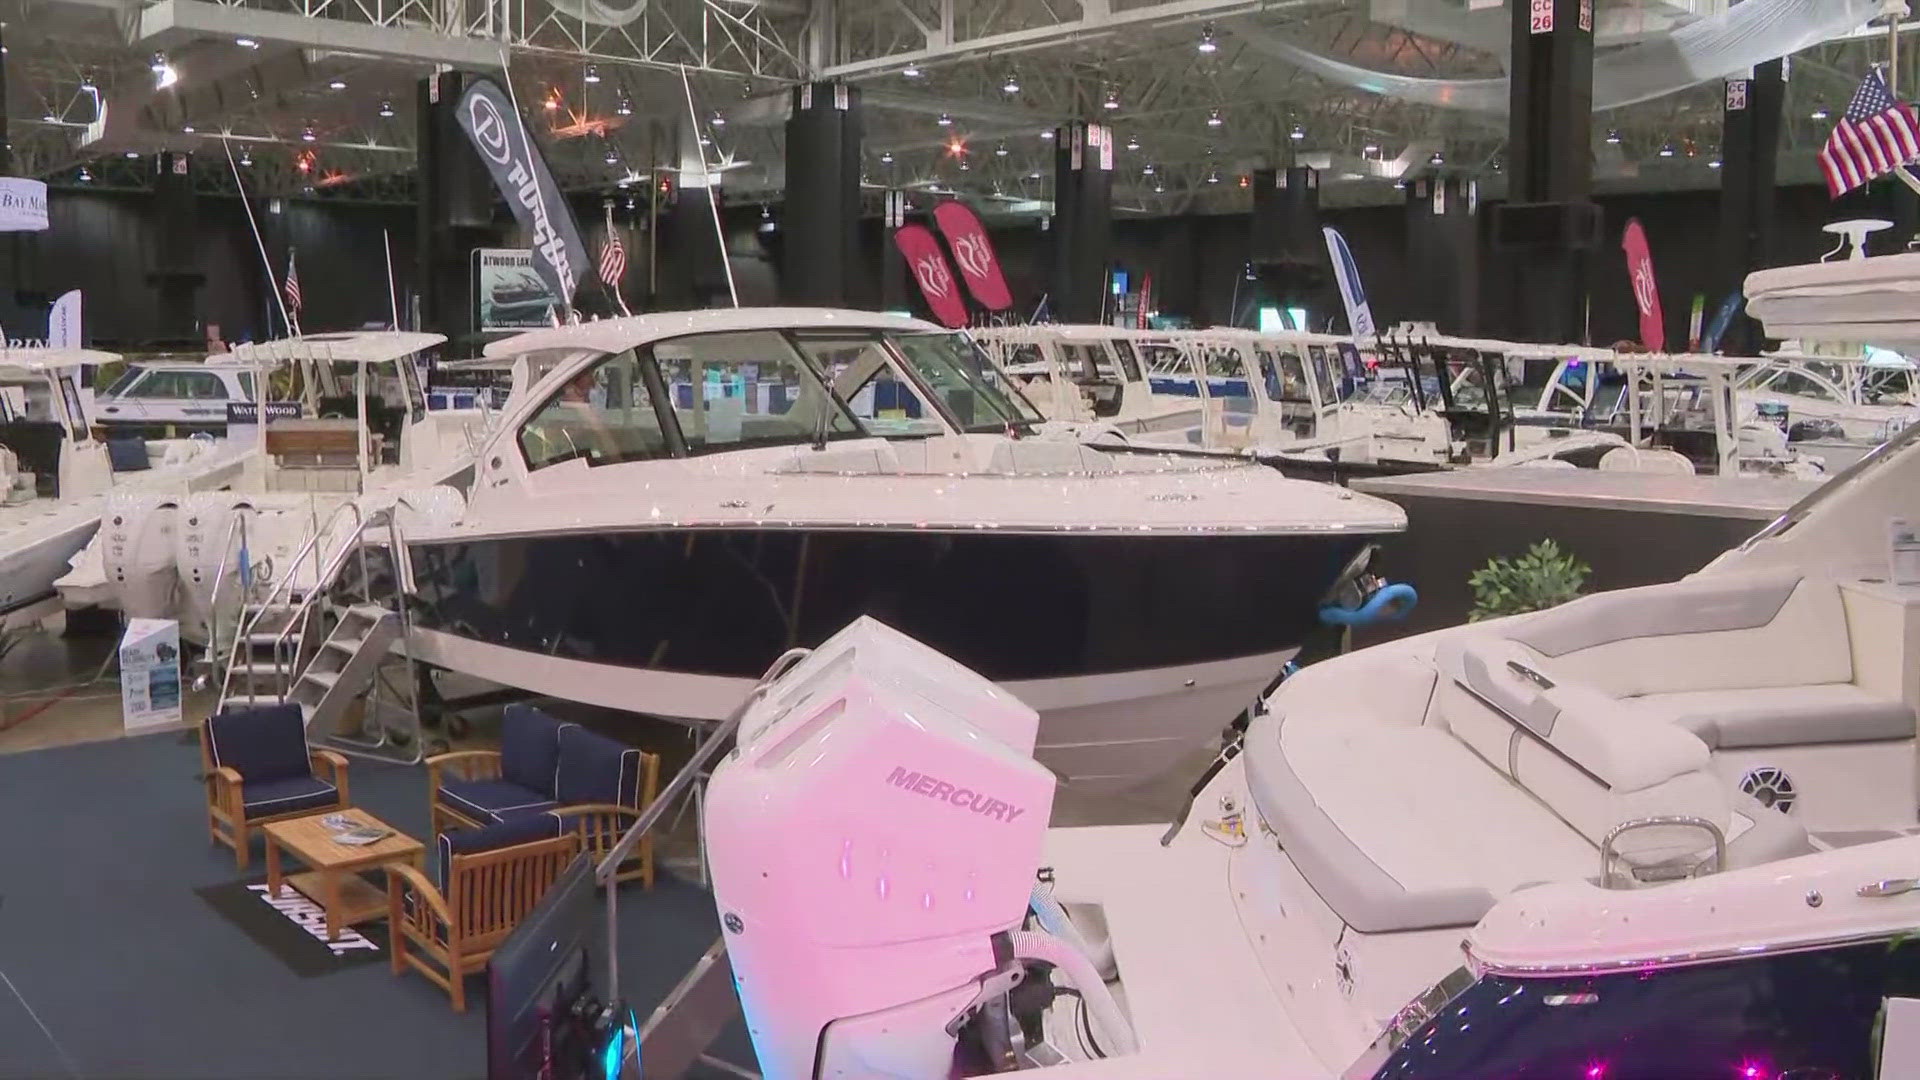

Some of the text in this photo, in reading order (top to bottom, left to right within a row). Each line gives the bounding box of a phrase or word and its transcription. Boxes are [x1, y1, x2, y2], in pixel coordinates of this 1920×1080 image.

[1532, 0, 1552, 12] CC
[1532, 16, 1552, 30] 26
[1728, 83, 1745, 93] CC
[1728, 96, 1744, 108] 24
[517, 256, 532, 267] LAK
[886, 766, 1024, 823] MERCURY
